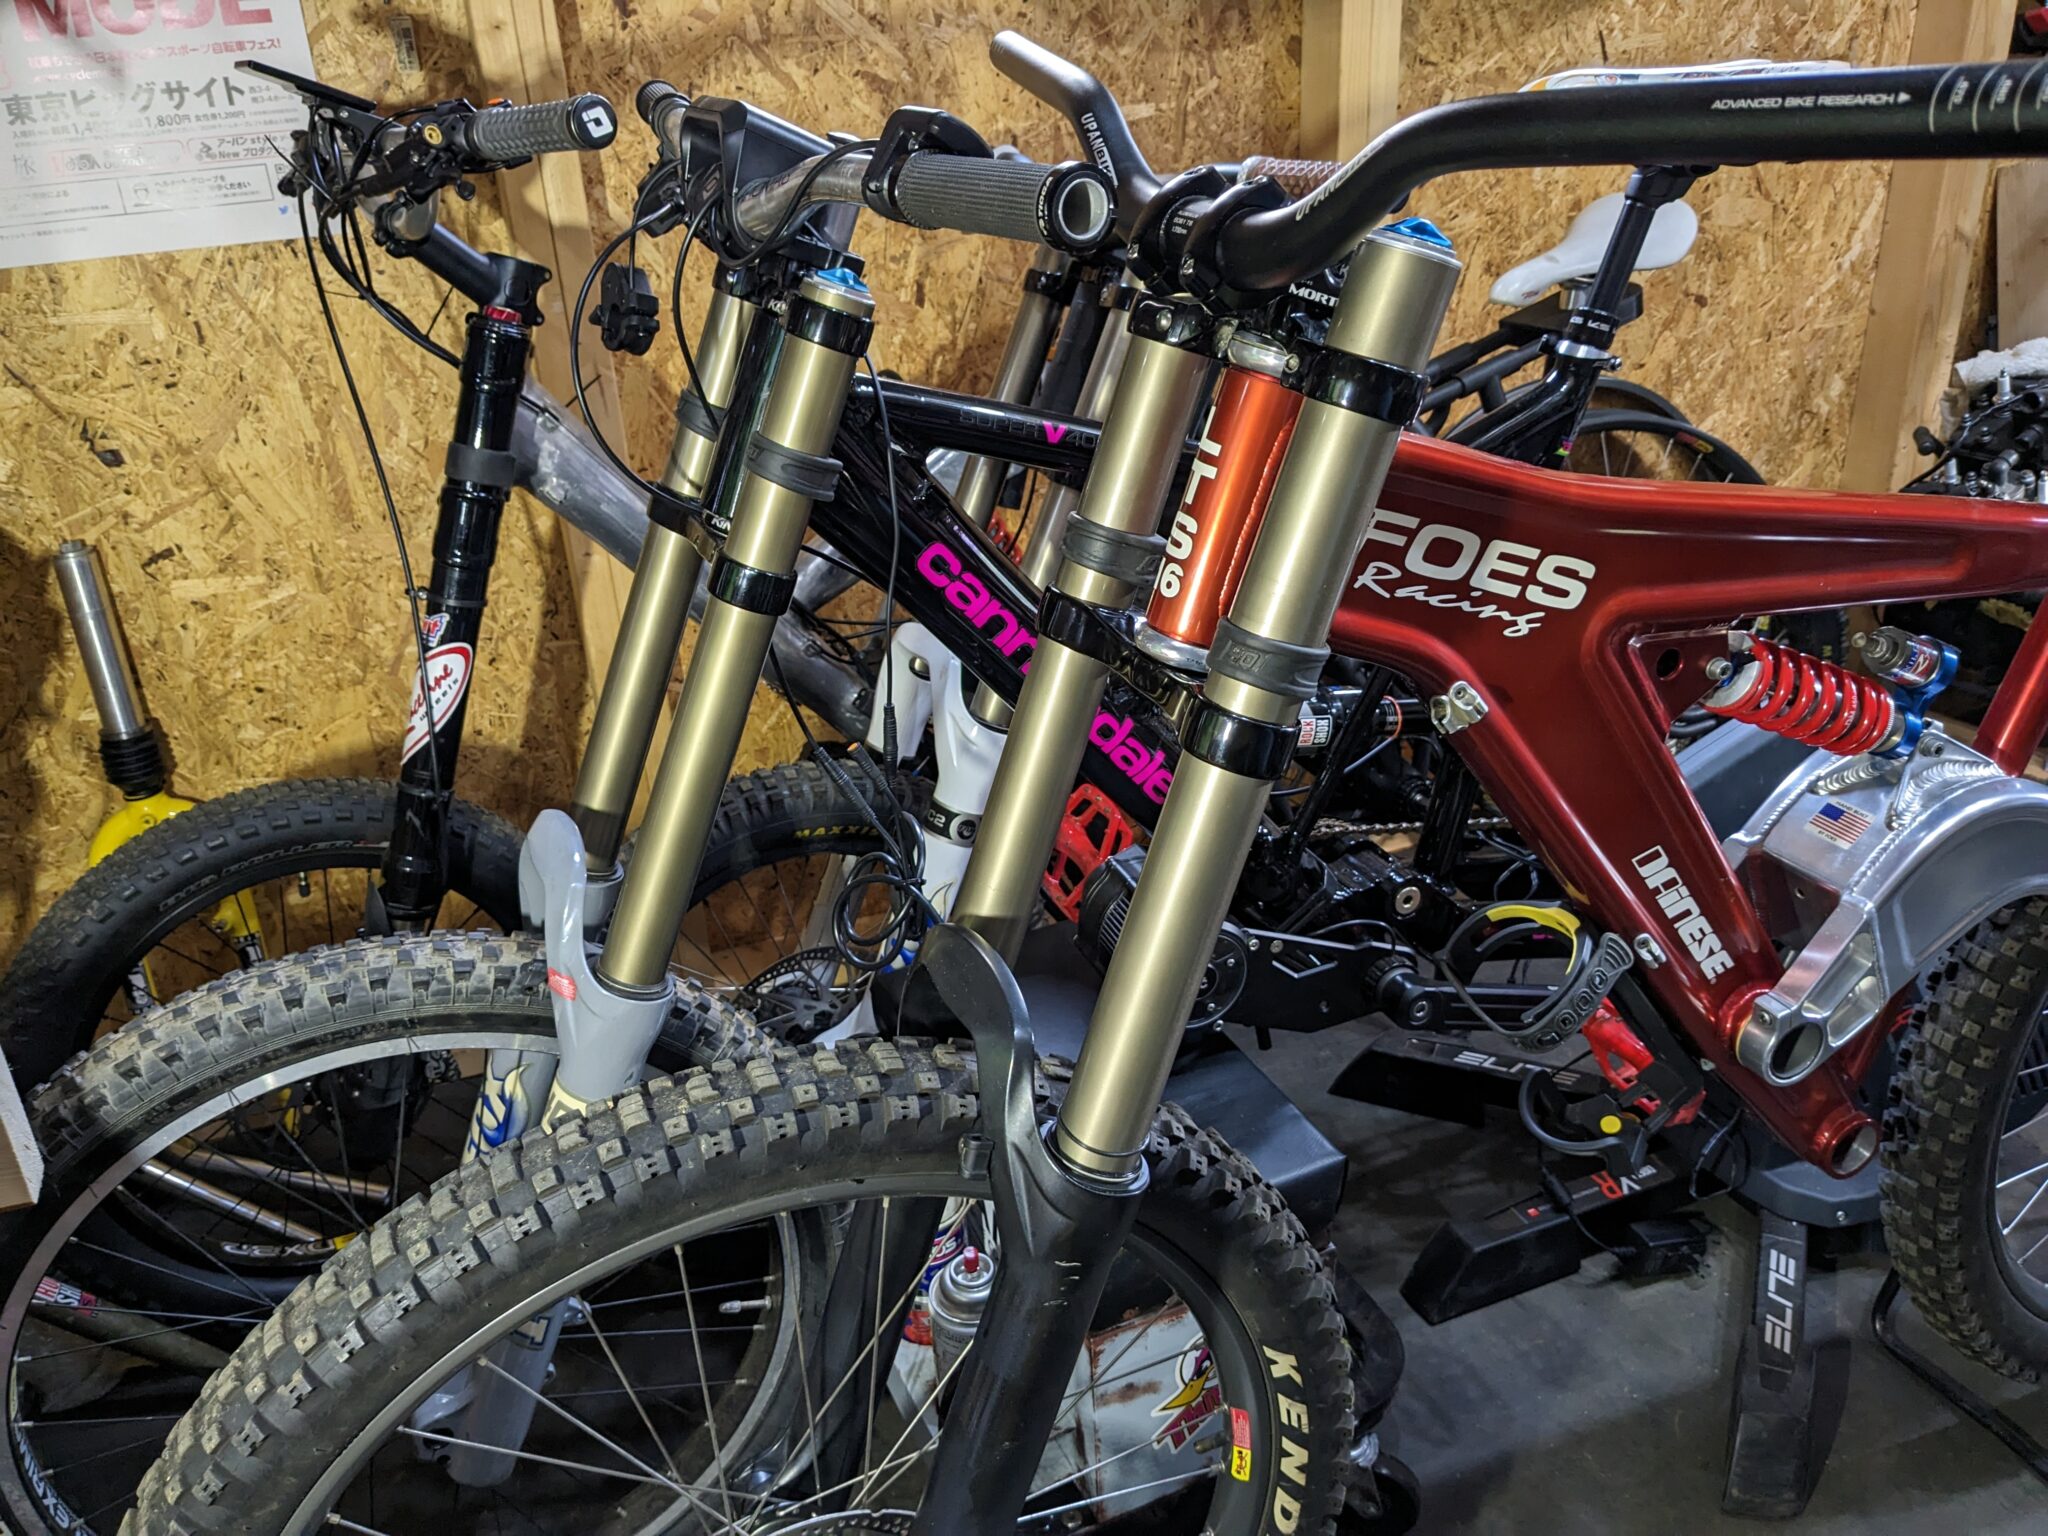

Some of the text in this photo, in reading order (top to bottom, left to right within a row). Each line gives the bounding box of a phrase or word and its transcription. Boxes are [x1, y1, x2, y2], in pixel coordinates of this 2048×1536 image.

[1711, 93, 1895, 109] ADVANCED BIKE RESEARCH
[1358, 508, 1596, 610] FOES
[1353, 561, 1546, 637] Racing
[1300, 719, 1314, 745] ROCK
[1314, 719, 1330, 745] SHOX
[794, 825, 880, 839] MAXXIS
[1453, 1051, 1582, 1086] ELITE
[1764, 1248, 1796, 1355] ELITE
[1262, 1345, 1310, 1536] KEND
